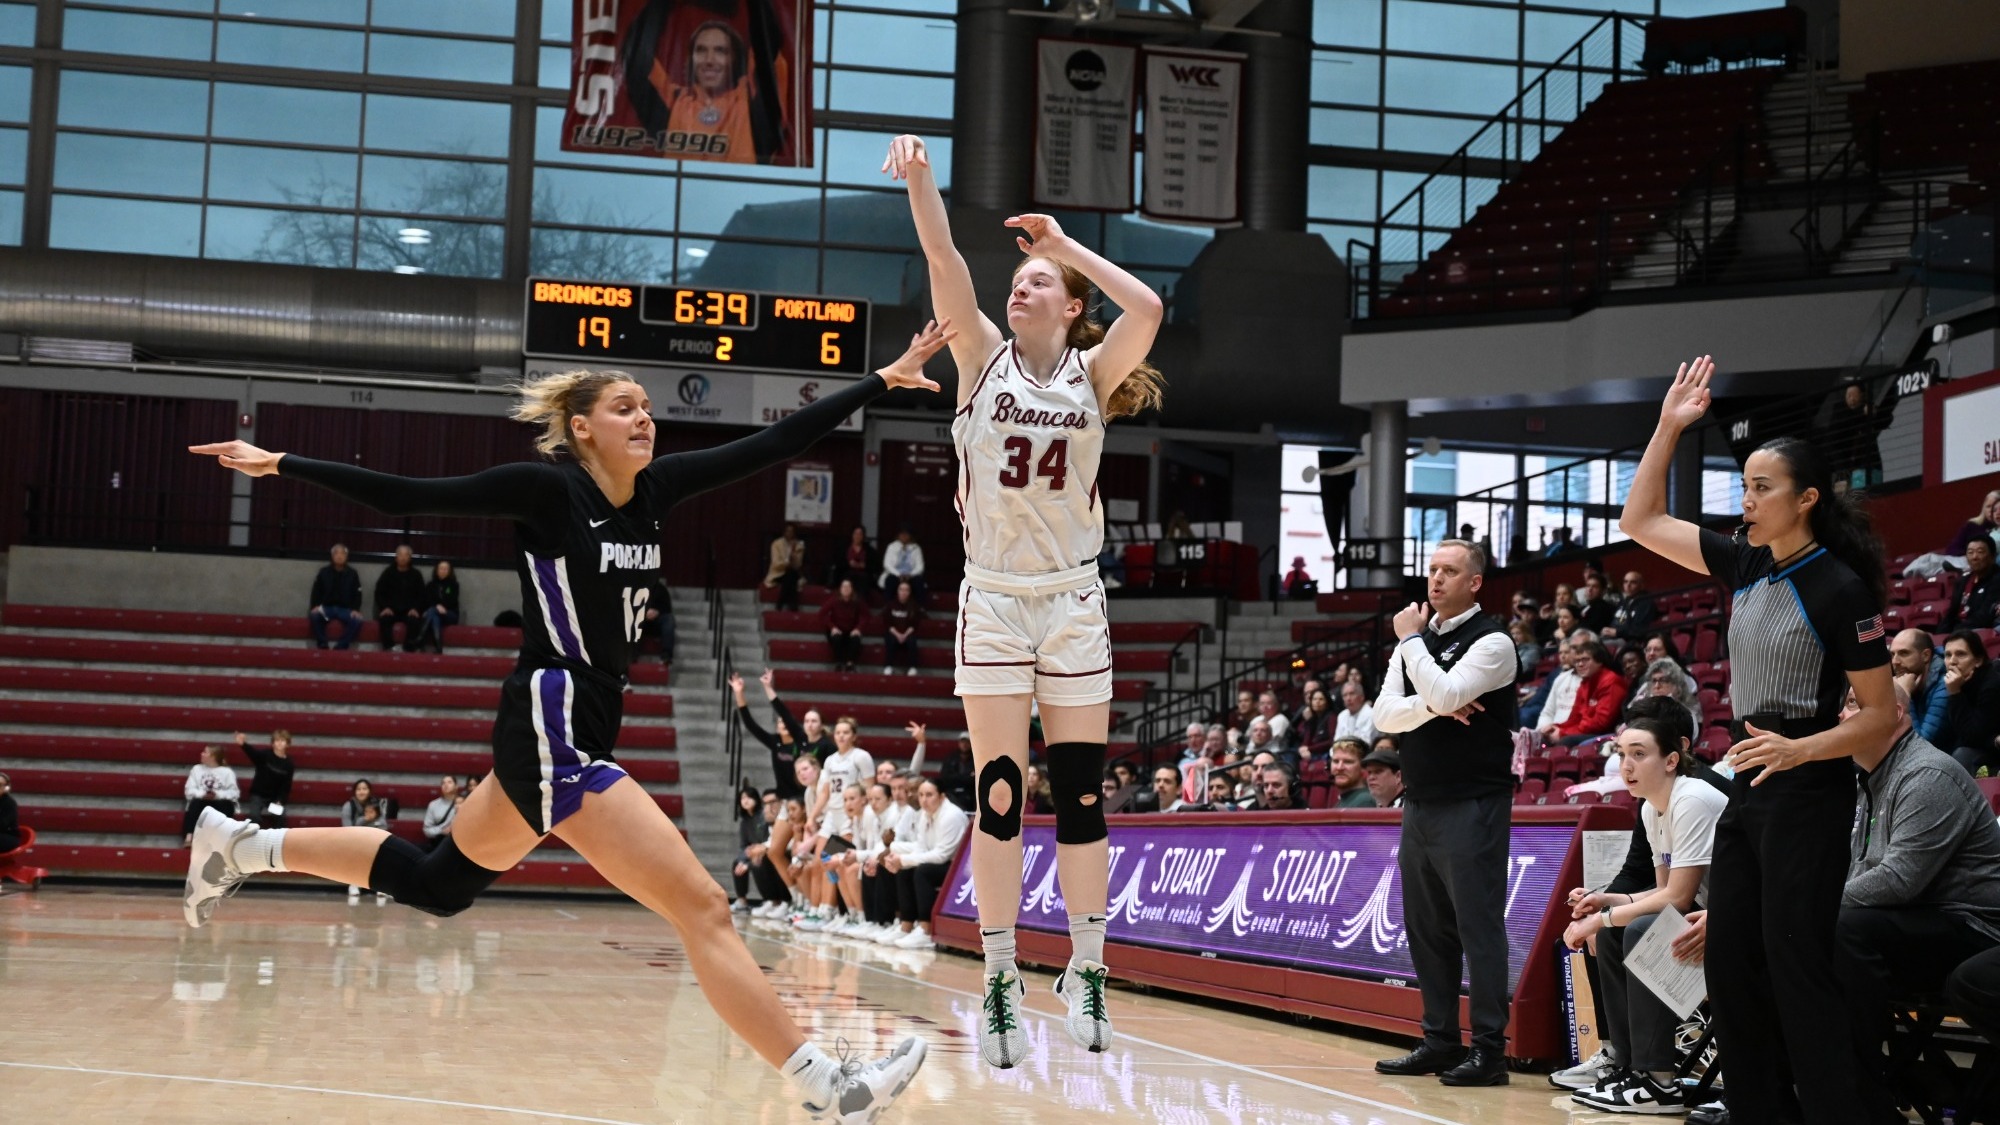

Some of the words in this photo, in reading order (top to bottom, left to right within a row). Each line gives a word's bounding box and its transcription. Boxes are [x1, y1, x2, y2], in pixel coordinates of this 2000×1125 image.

[1169, 64, 1221, 87] WCC
[571, 124, 729, 156] 1992-1996
[534, 282, 633, 308] BRONCOS
[674, 290, 748, 326] 6:39
[774, 298, 855, 324] PORTLAND
[577, 316, 611, 349] 19
[669, 338, 714, 355] PERIOD
[715, 336, 734, 361] 2
[820, 331, 842, 365] 6
[1067, 374, 1085, 387] WCC
[1897, 372, 1921, 396] 102
[349, 389, 374, 404] 114
[667, 406, 691, 417] WEST
[693, 408, 721, 418] COAST
[762, 407, 799, 423] SAN
[991, 392, 1089, 430] Broncos
[1731, 419, 1749, 441] 101
[999, 435, 1068, 491] 34
[599, 542, 661, 573] PORTLAN
[1179, 543, 1205, 560] 115
[1349, 543, 1376, 560] 115
[622, 586, 650, 642] 12
[1151, 847, 1227, 896] STUART
[1263, 849, 1357, 905] STUART
[1140, 903, 1165, 921] event
[1168, 904, 1202, 925] rentals
[1250, 914, 1280, 933] event
[1286, 915, 1330, 939] rentals
[1564, 955, 1573, 999] WOMEN'S
[1567, 1001, 1578, 1061] BASKETBALL
